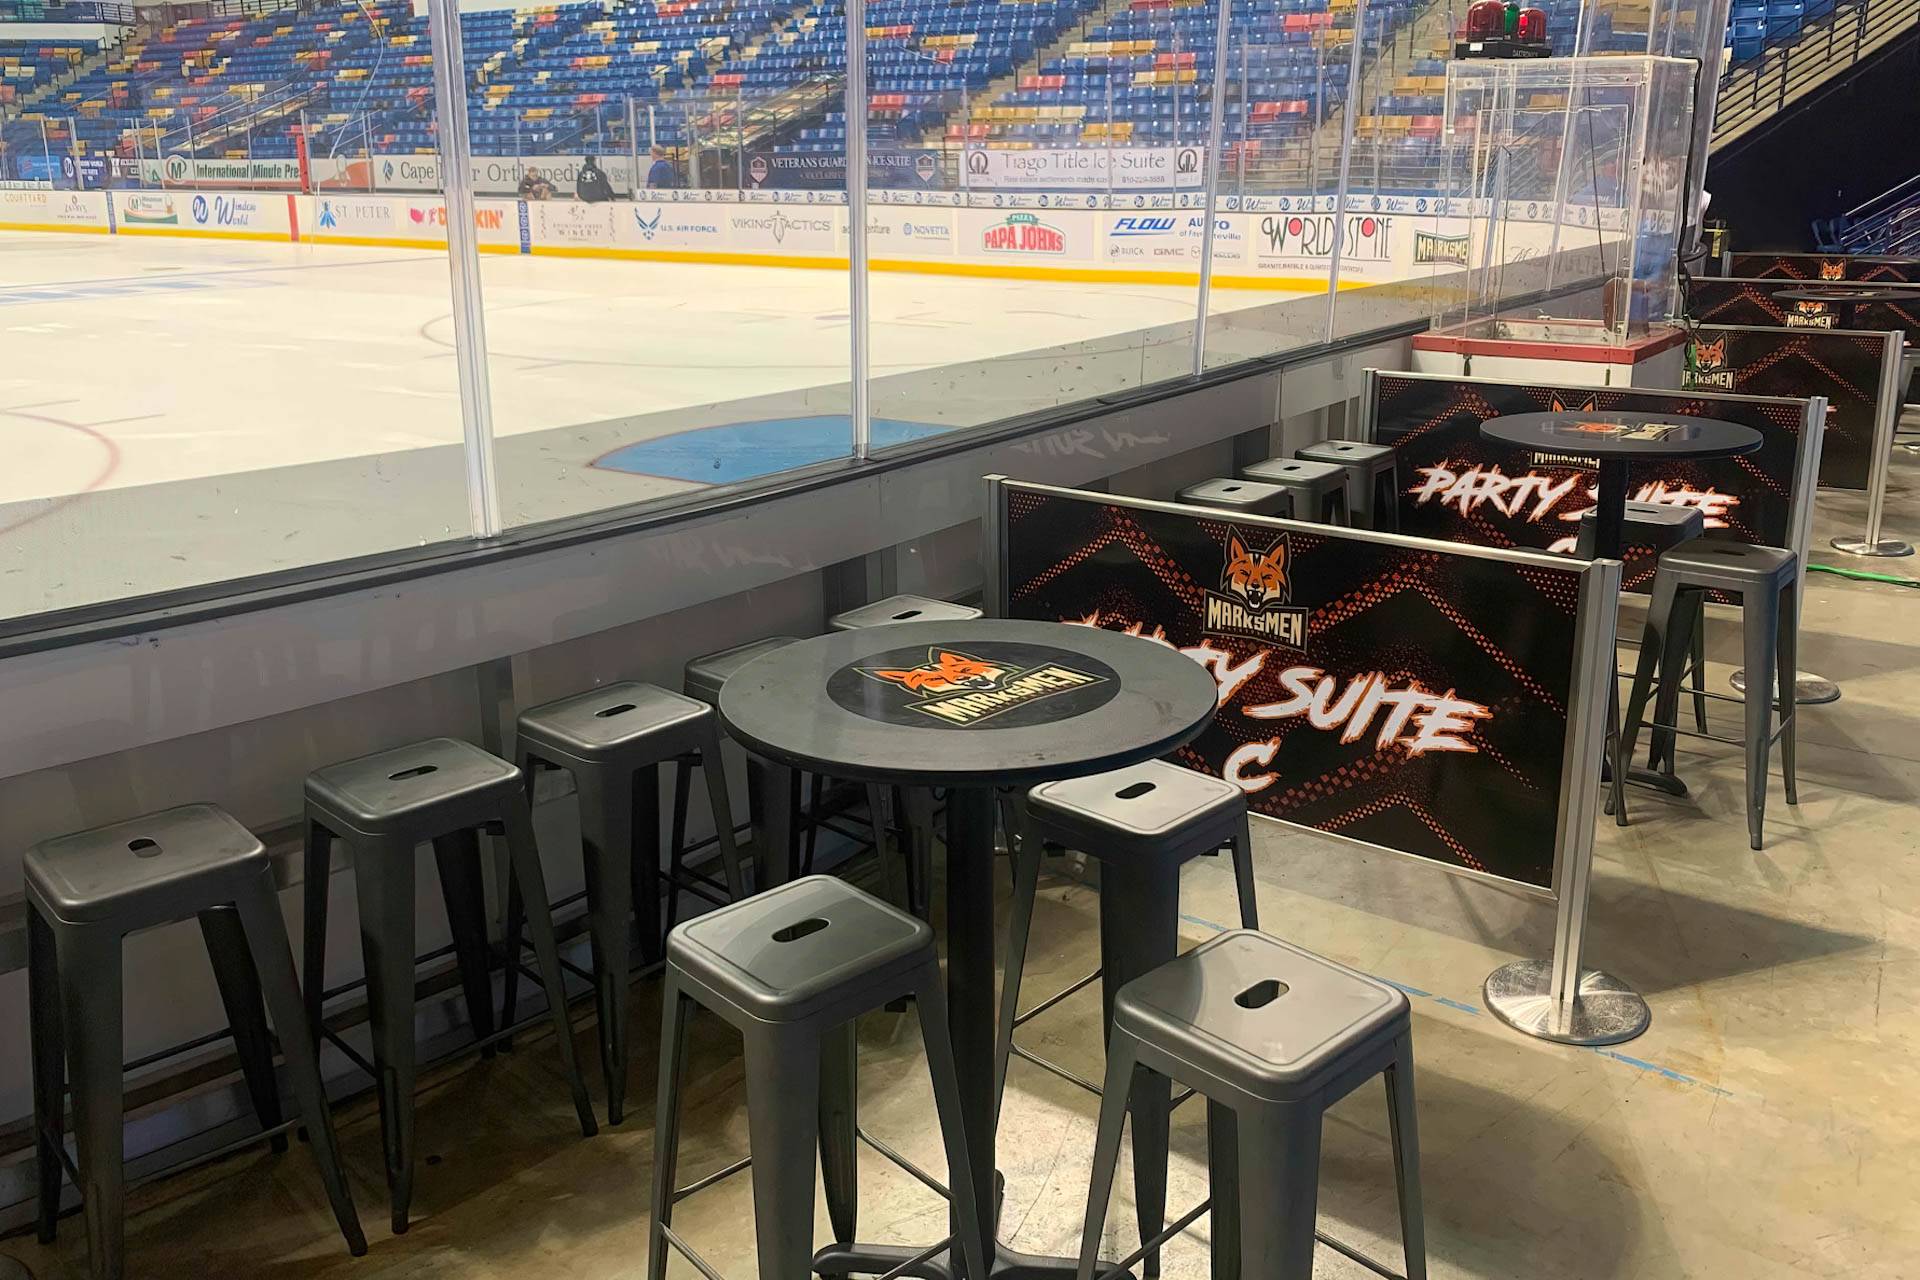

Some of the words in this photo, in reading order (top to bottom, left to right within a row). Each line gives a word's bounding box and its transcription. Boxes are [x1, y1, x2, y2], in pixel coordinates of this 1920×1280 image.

[196, 163, 249, 179] International
[253, 162, 282, 179] Minute
[285, 163, 300, 179] Pre
[400, 161, 434, 183] Cape
[771, 158, 818, 168] VETERANS
[818, 156, 873, 168] GUARDN
[1001, 153, 1047, 177] Tiago
[1051, 152, 1087, 169] Title
[1121, 151, 1165, 169] Suite
[690, 225, 718, 233] FORCE
[732, 218, 773, 230] VIKING
[1114, 217, 1177, 231] FLOW
[1262, 216, 1343, 256] WORLD
[1348, 217, 1392, 258] STONE
[984, 226, 1017, 250] PAPA
[1020, 225, 1064, 252] JOHNS
[1153, 248, 1185, 256] GMC
[1408, 458, 1582, 522] PARTY
[1207, 597, 1303, 646] MARKSMEN
[922, 667, 1096, 722] MARKSMEN
[1243, 666, 1493, 758] SUITE
[1222, 737, 1282, 794] C
